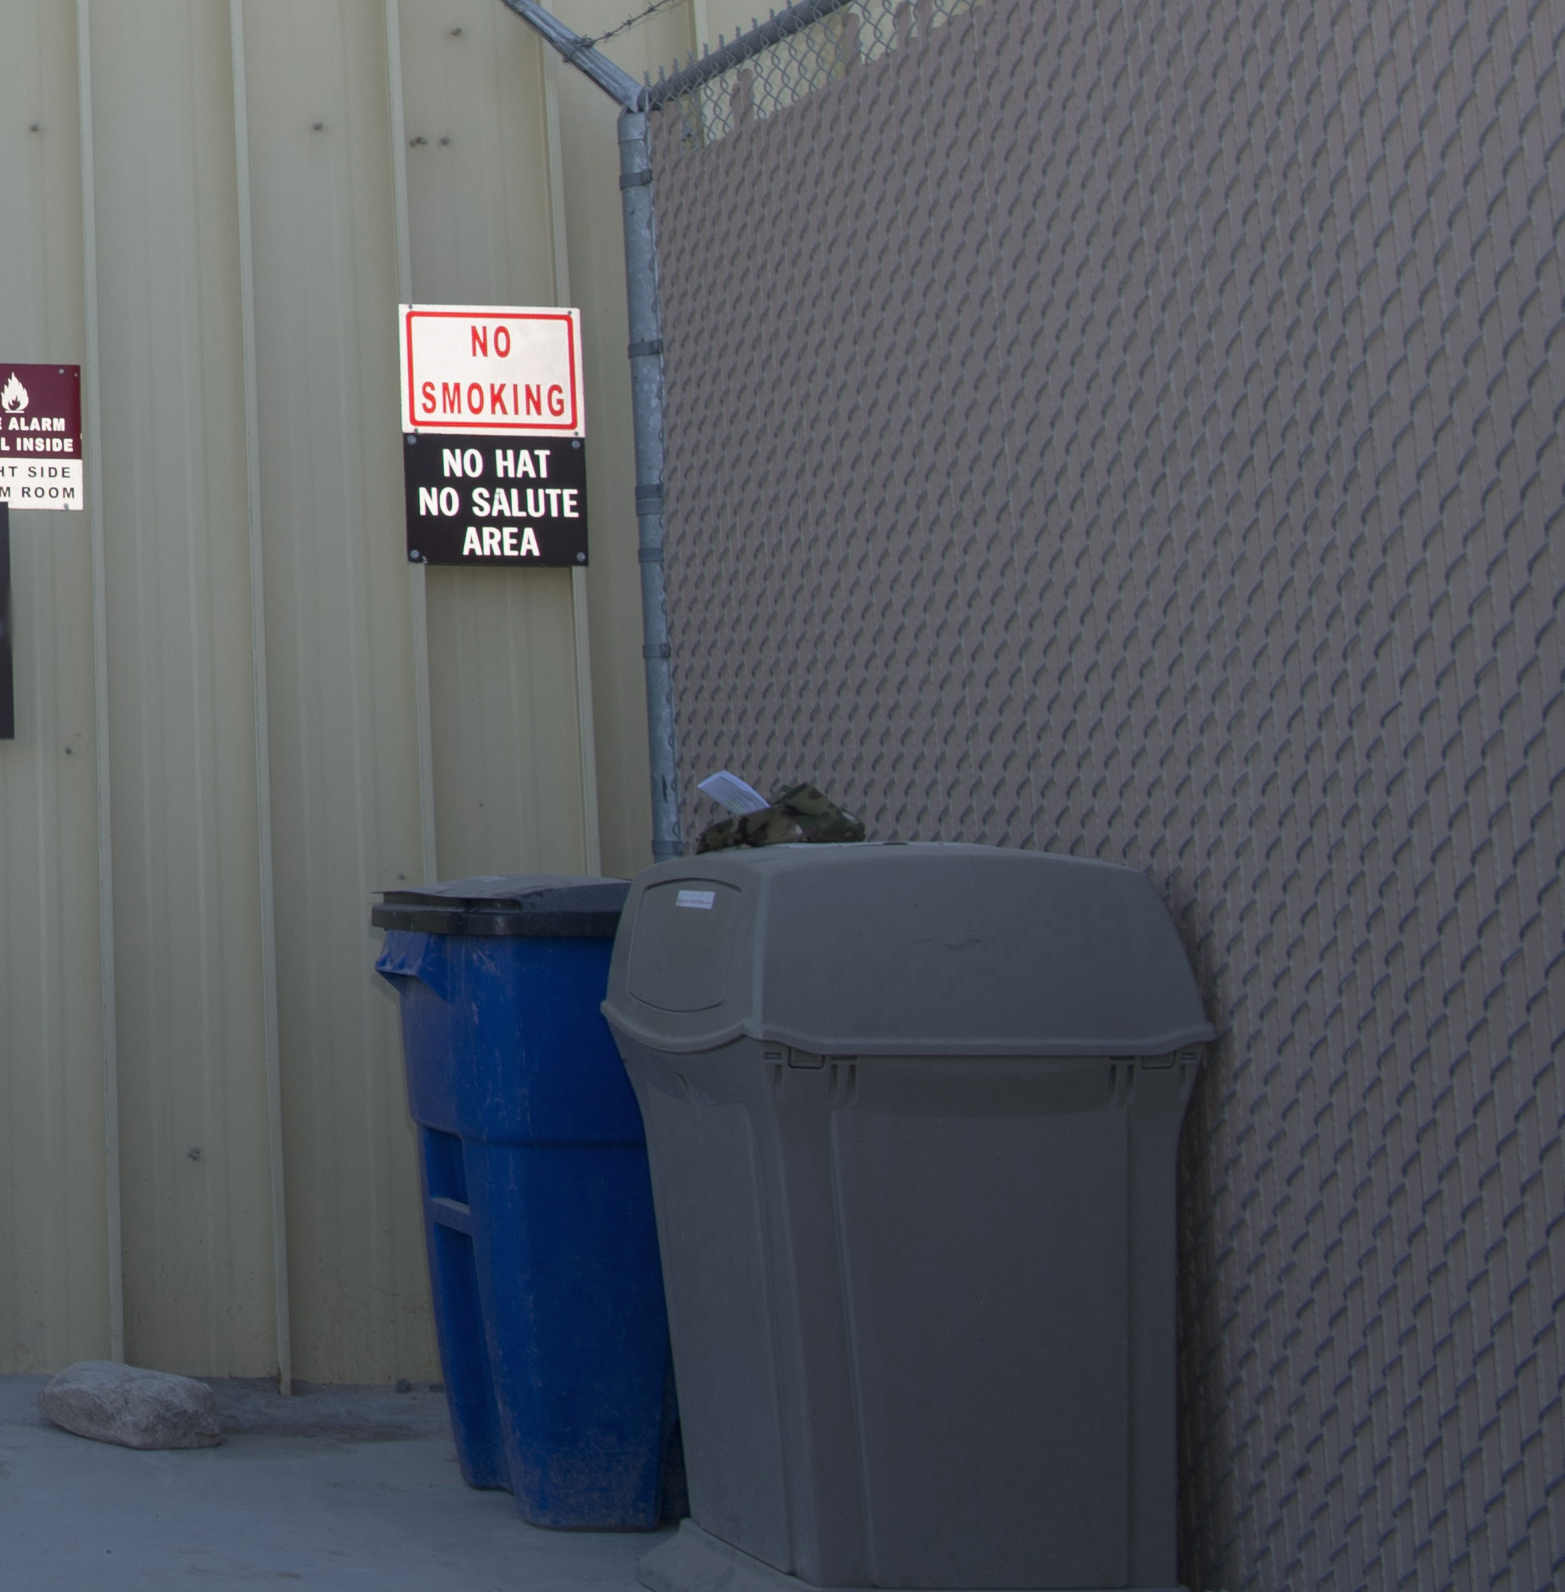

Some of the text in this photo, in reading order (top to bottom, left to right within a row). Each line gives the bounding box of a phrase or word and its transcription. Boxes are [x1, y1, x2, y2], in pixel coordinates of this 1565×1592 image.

[471, 325, 511, 358] NO
[421, 381, 565, 417] SMOKING
[8, 417, 66, 432] ALARM
[16, 437, 74, 452] INSIDE
[27, 466, 71, 479] SIDE
[442, 448, 551, 478] NO HAT
[21, 486, 75, 499] ROOM
[418, 487, 579, 518] NO SALUTE
[462, 526, 541, 557] AREA
